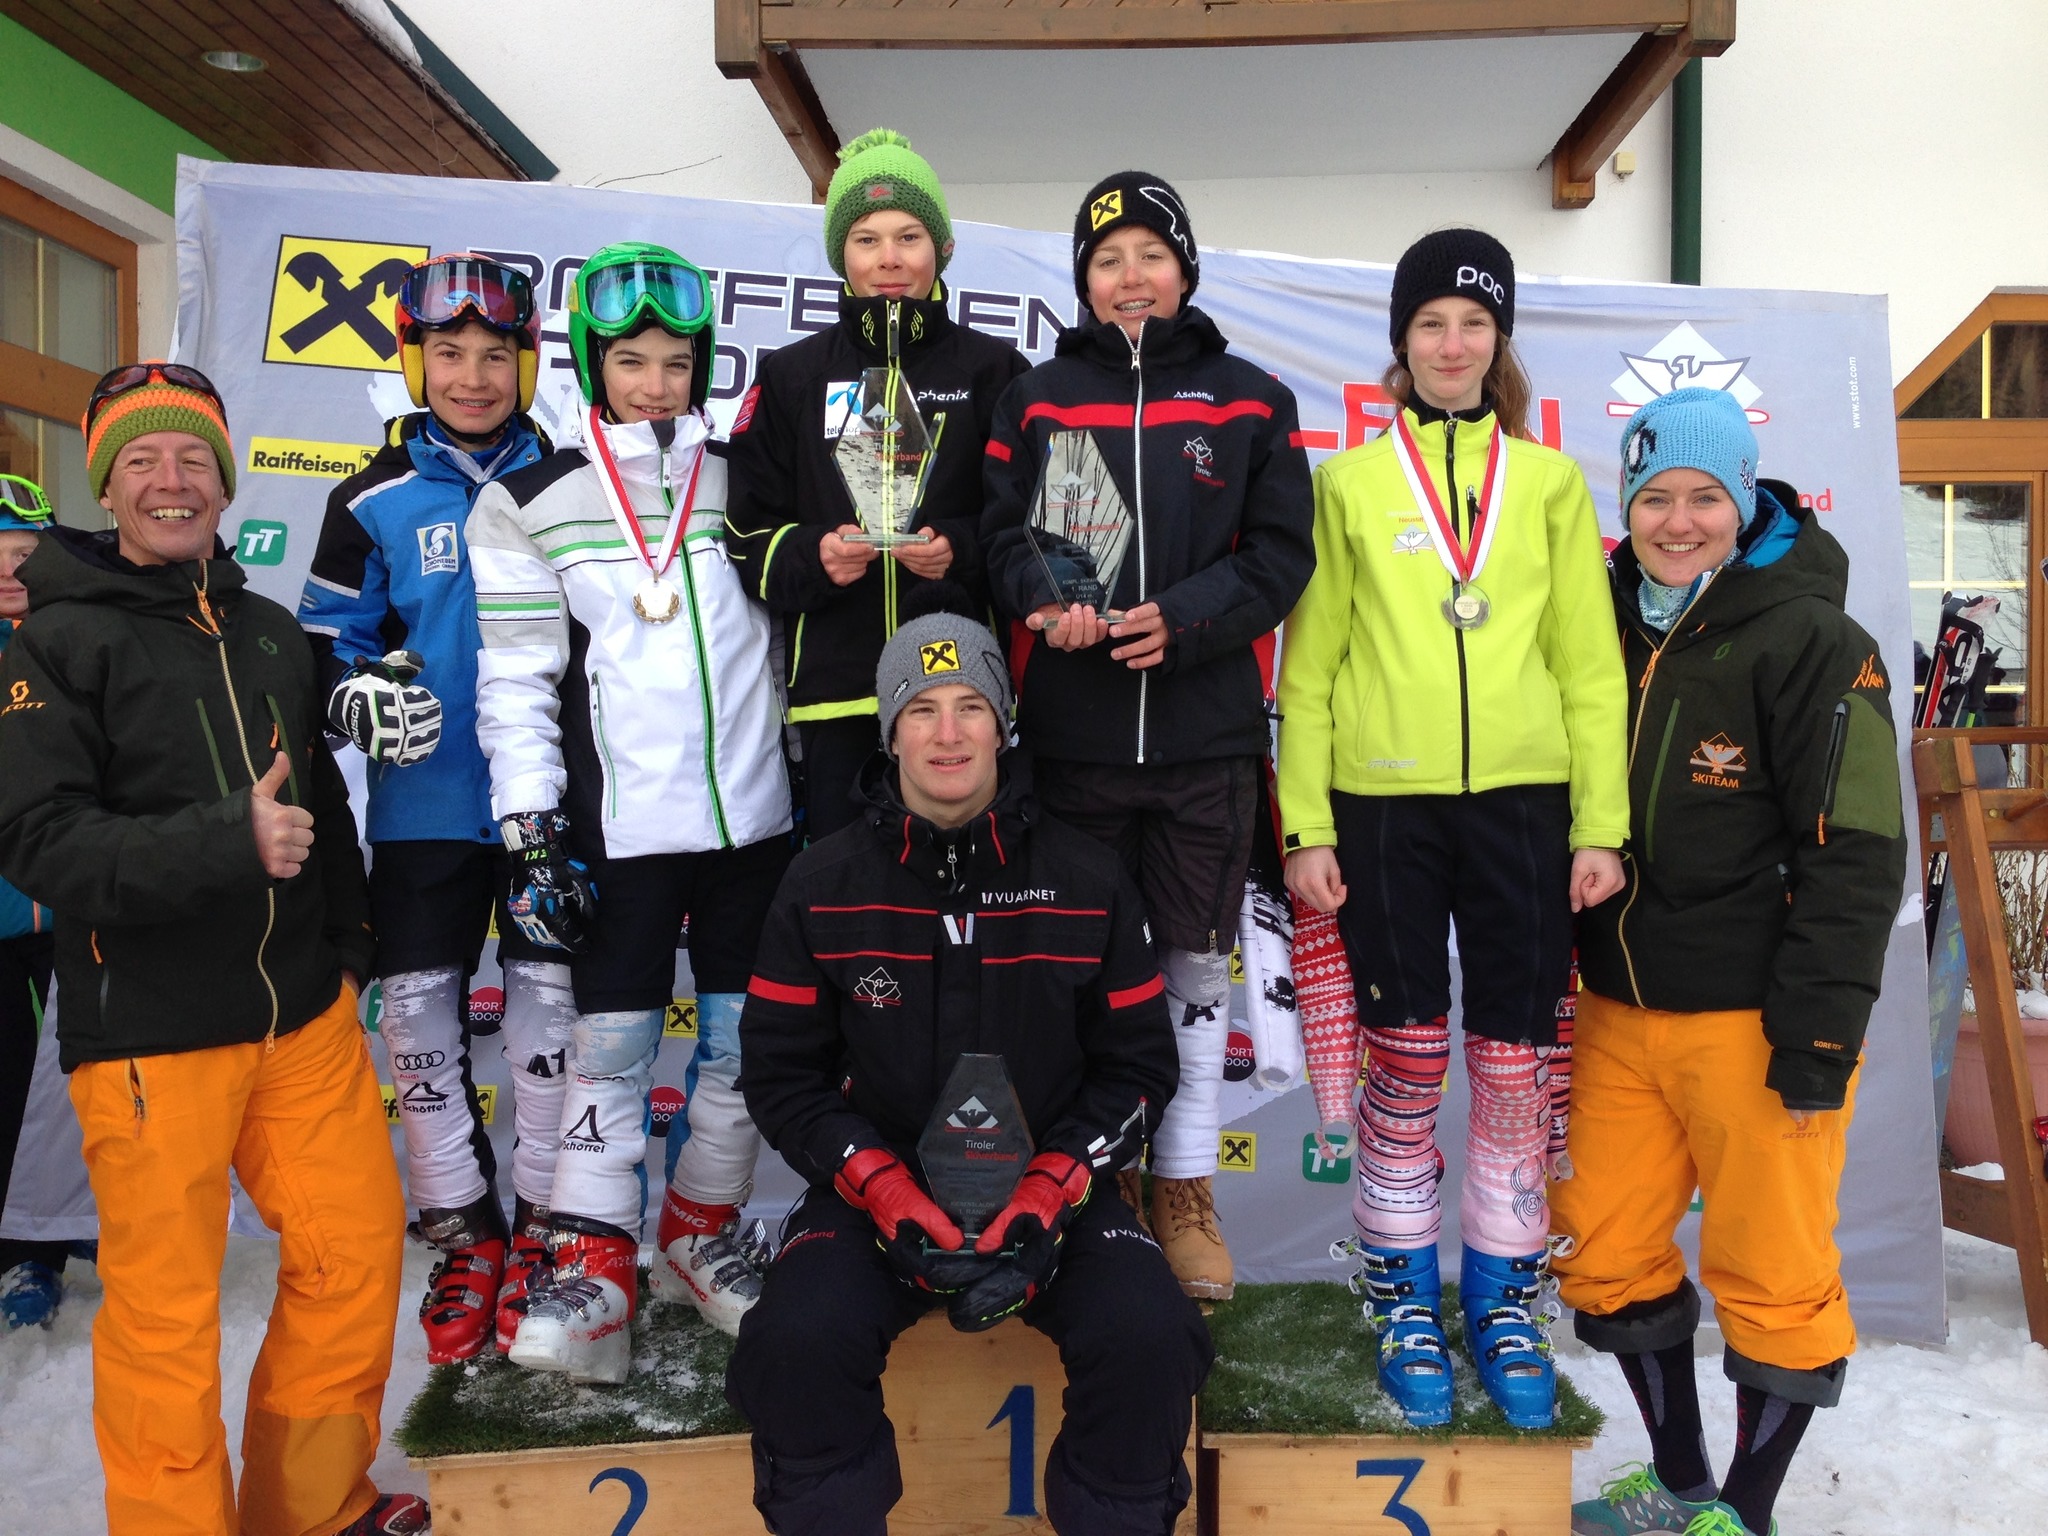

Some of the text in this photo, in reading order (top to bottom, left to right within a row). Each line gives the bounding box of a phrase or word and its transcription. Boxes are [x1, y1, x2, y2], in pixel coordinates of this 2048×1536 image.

[917, 389, 970, 401] phenix
[1849, 356, 1861, 429] www.stot.com
[252, 450, 357, 475] Raiffeisen
[1691, 772, 1740, 789] SKITEAM
[995, 888, 1056, 904] VUARNET
[468, 1001, 504, 1012] SPOR
[468, 1012, 502, 1022] 2000
[1225, 1047, 1254, 1058] PORT
[1225, 1057, 1251, 1068] 000
[576, 1076, 594, 1086] Audi
[403, 1101, 448, 1114] Schöffel
[651, 1102, 686, 1112] PORT
[965, 1139, 996, 1150] Tiroler
[985, 1384, 1036, 1517] 1
